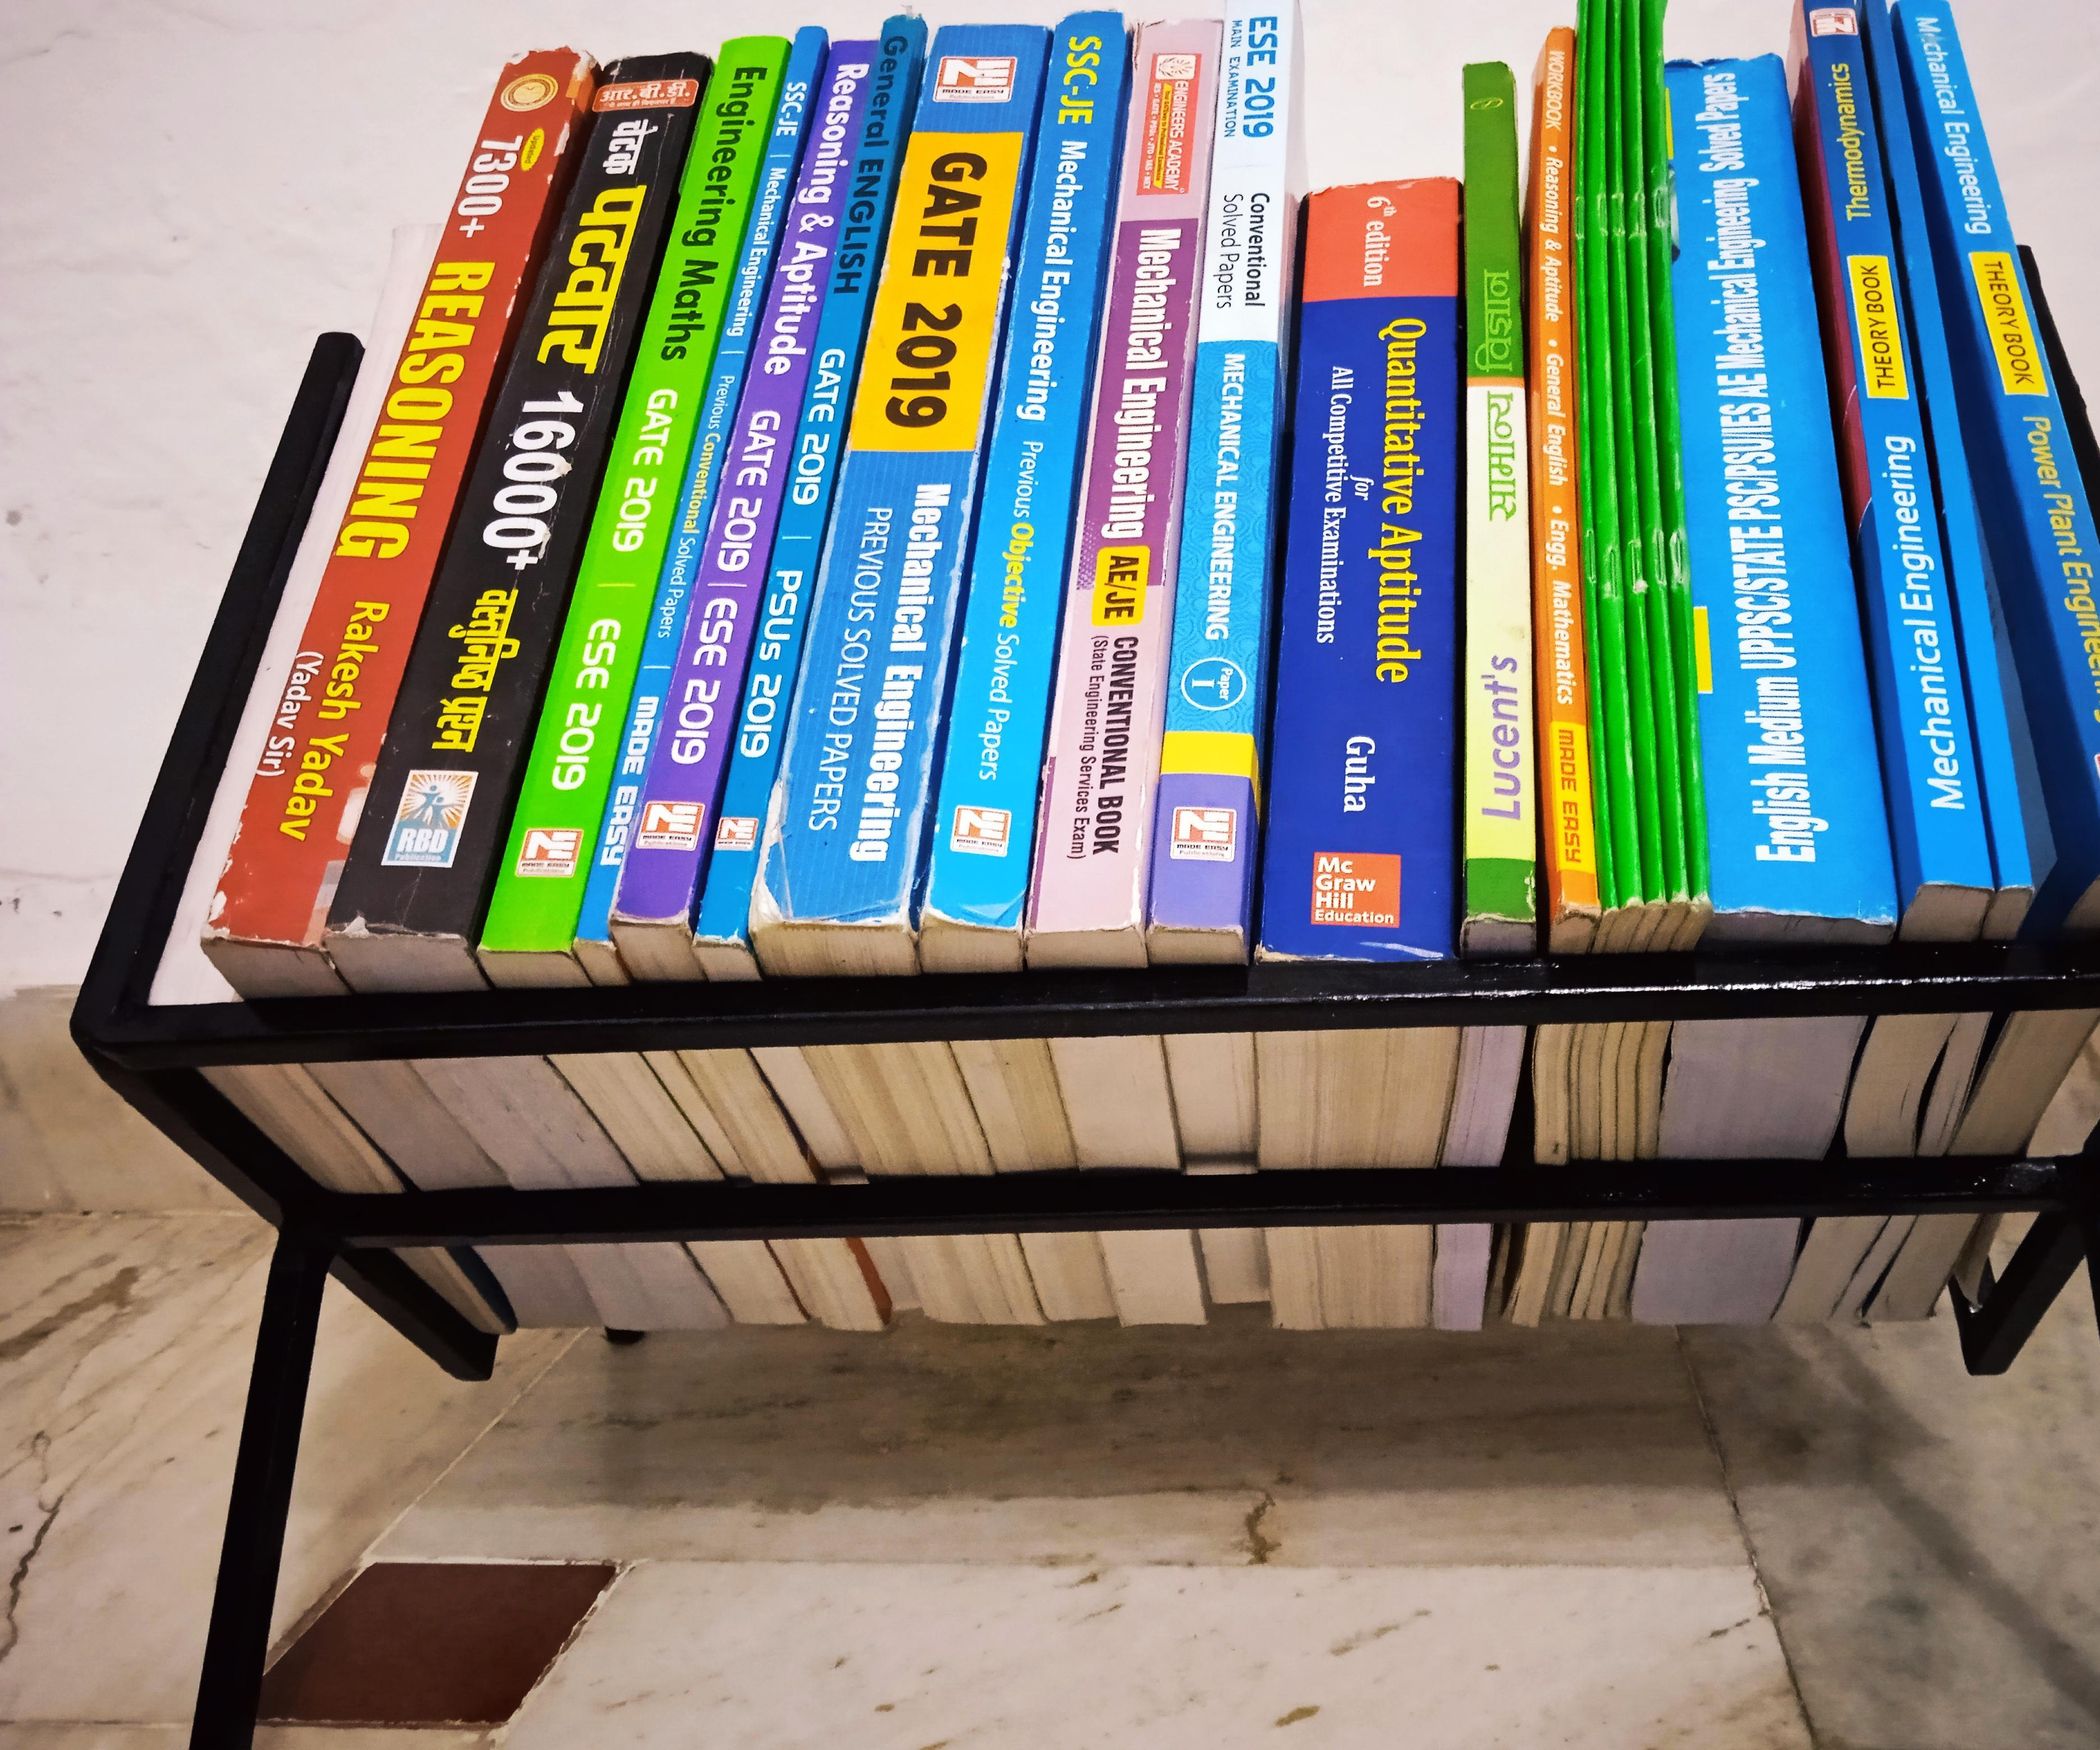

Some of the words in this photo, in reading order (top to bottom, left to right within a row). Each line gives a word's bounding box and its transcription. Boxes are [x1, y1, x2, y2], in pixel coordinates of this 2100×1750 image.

[1230, 20, 1243, 48] MAIN
[1246, 16, 1278, 67] ESE
[775, 82, 808, 137] SSC-JE
[863, 35, 909, 149] General
[1057, 36, 1103, 125] SSC-JE
[1170, 80, 1189, 138] ENGINEERS
[1224, 56, 1241, 138] EXAMINATION
[1242, 77, 1276, 138] 2019
[1545, 50, 1566, 131] WORKBOOK
[1695, 72, 1750, 122] Papers
[681, 66, 768, 247] Engineering
[797, 63, 871, 204] Reasoning
[1164, 140, 1184, 190] ACADEMY
[1696, 123, 1746, 172] Solved
[1826, 62, 1872, 222] Thermodynamics
[459, 135, 523, 239] 7300+
[750, 166, 786, 247] Mechanical
[911, 151, 988, 281] GATE
[1044, 140, 1089, 266] Mechanical
[1540, 156, 1563, 234] Reasoning
[1943, 121, 1993, 236] Engineering
[797, 213, 835, 233] &
[832, 157, 885, 295] ENGLISH
[1220, 193, 1244, 249] Solved
[1244, 193, 1270, 307] Conventional
[1363, 220, 1390, 287] edition
[1545, 237, 1562, 252] &
[1701, 177, 1767, 271] Engineering
[537, 183, 648, 375] पटवार
[660, 258, 720, 363] Maths
[725, 248, 769, 338] Engineering
[763, 241, 829, 377] Aptitude
[1125, 228, 1182, 370] Mechanical
[1213, 253, 1240, 309] Papers
[1542, 254, 1565, 322] Aptitude
[1860, 265, 1885, 314] BOOK
[1016, 271, 1071, 422] Engineering
[1474, 269, 1512, 373] विज्ञान
[1708, 273, 1766, 370] Mechanical
[1867, 317, 1895, 390] THEORY
[1984, 261, 2020, 329] THEORY
[2003, 333, 2035, 385] BOOK
[708, 375, 736, 430] Previous
[807, 348, 846, 423] GATE
[885, 302, 962, 429] 2019
[1331, 366, 1354, 390] All
[1545, 353, 1564, 417] General
[1716, 373, 1769, 398] AE
[333, 261, 496, 560] REASONING
[632, 388, 679, 466] GATE
[736, 410, 781, 487] GATE
[1216, 353, 1246, 487] MECHANICAL
[1322, 393, 1352, 503] Competitive
[1378, 317, 1428, 515] Quantitative
[482, 390, 585, 571] 16000+
[682, 433, 722, 534] Conventional
[791, 433, 830, 505] 2019
[1013, 440, 1044, 519] Previous
[1100, 377, 1167, 539] Engineering
[1350, 475, 1375, 501] for
[1486, 391, 1517, 523] सामान्य
[1544, 423, 1568, 487] English
[2022, 415, 2061, 489] Power
[2043, 493, 2083, 557] Plant
[611, 477, 658, 553] 2019
[716, 497, 763, 572] 2019
[1545, 512, 1570, 571] Engg.
[1881, 436, 1935, 612] Engineering
[670, 536, 697, 585] Solved
[846, 506, 894, 624] PREVIOUS
[890, 482, 952, 653] Mechanical
[999, 522, 1035, 629] Objective
[1103, 555, 1140, 620] AE/JE
[1205, 491, 1238, 641] ENGINEERING
[1316, 507, 1347, 645] Examinations
[1729, 525, 1798, 670] UPPSC/STATE
[447, 588, 520, 693] वस्तुनिष्ठ
[657, 589, 686, 639] Papers
[692, 597, 739, 667] ESE
[758, 570, 804, 661] PSUs
[1368, 522, 1423, 684] Aptitude
[1552, 581, 1574, 706] Mathematics
[281, 650, 325, 731] (Yadav
[324, 600, 391, 722] Rakesh
[575, 618, 622, 690] ESE
[828, 627, 870, 728] SOLVED
[989, 633, 1020, 704] Solved
[1090, 635, 1108, 671] (State
[1217, 667, 1235, 701] Paper
[431, 695, 488, 753] प्रश्न
[551, 703, 603, 791] 2019
[670, 679, 721, 765] 2019
[740, 674, 783, 758] 2019
[978, 708, 1011, 781] Papers
[1079, 675, 1104, 752] Engineering
[1099, 636, 1139, 790] CONVENTIONAL
[1481, 655, 1522, 821] Lucent's
[1745, 676, 1806, 766] Medium
[1903, 614, 1966, 810] Mechanical
[255, 734, 296, 778] Sir)
[279, 732, 351, 842] Yadav
[808, 732, 853, 833] PAPERS
[848, 663, 925, 863] Engineering
[1075, 756, 1097, 813] Services
[1343, 735, 1376, 813] Guha
[1557, 729, 1577, 793] MADE
[396, 828, 449, 853] RBD
[1066, 817, 1091, 860] Exam)
[1092, 795, 1124, 856] BOOK
[1560, 803, 1582, 864] EASY
[1750, 769, 1829, 863] English
[1315, 875, 1376, 893] Graw
[1315, 892, 1354, 909] Hill
[1317, 856, 1353, 874] Mc
[1314, 910, 1395, 924] Education
